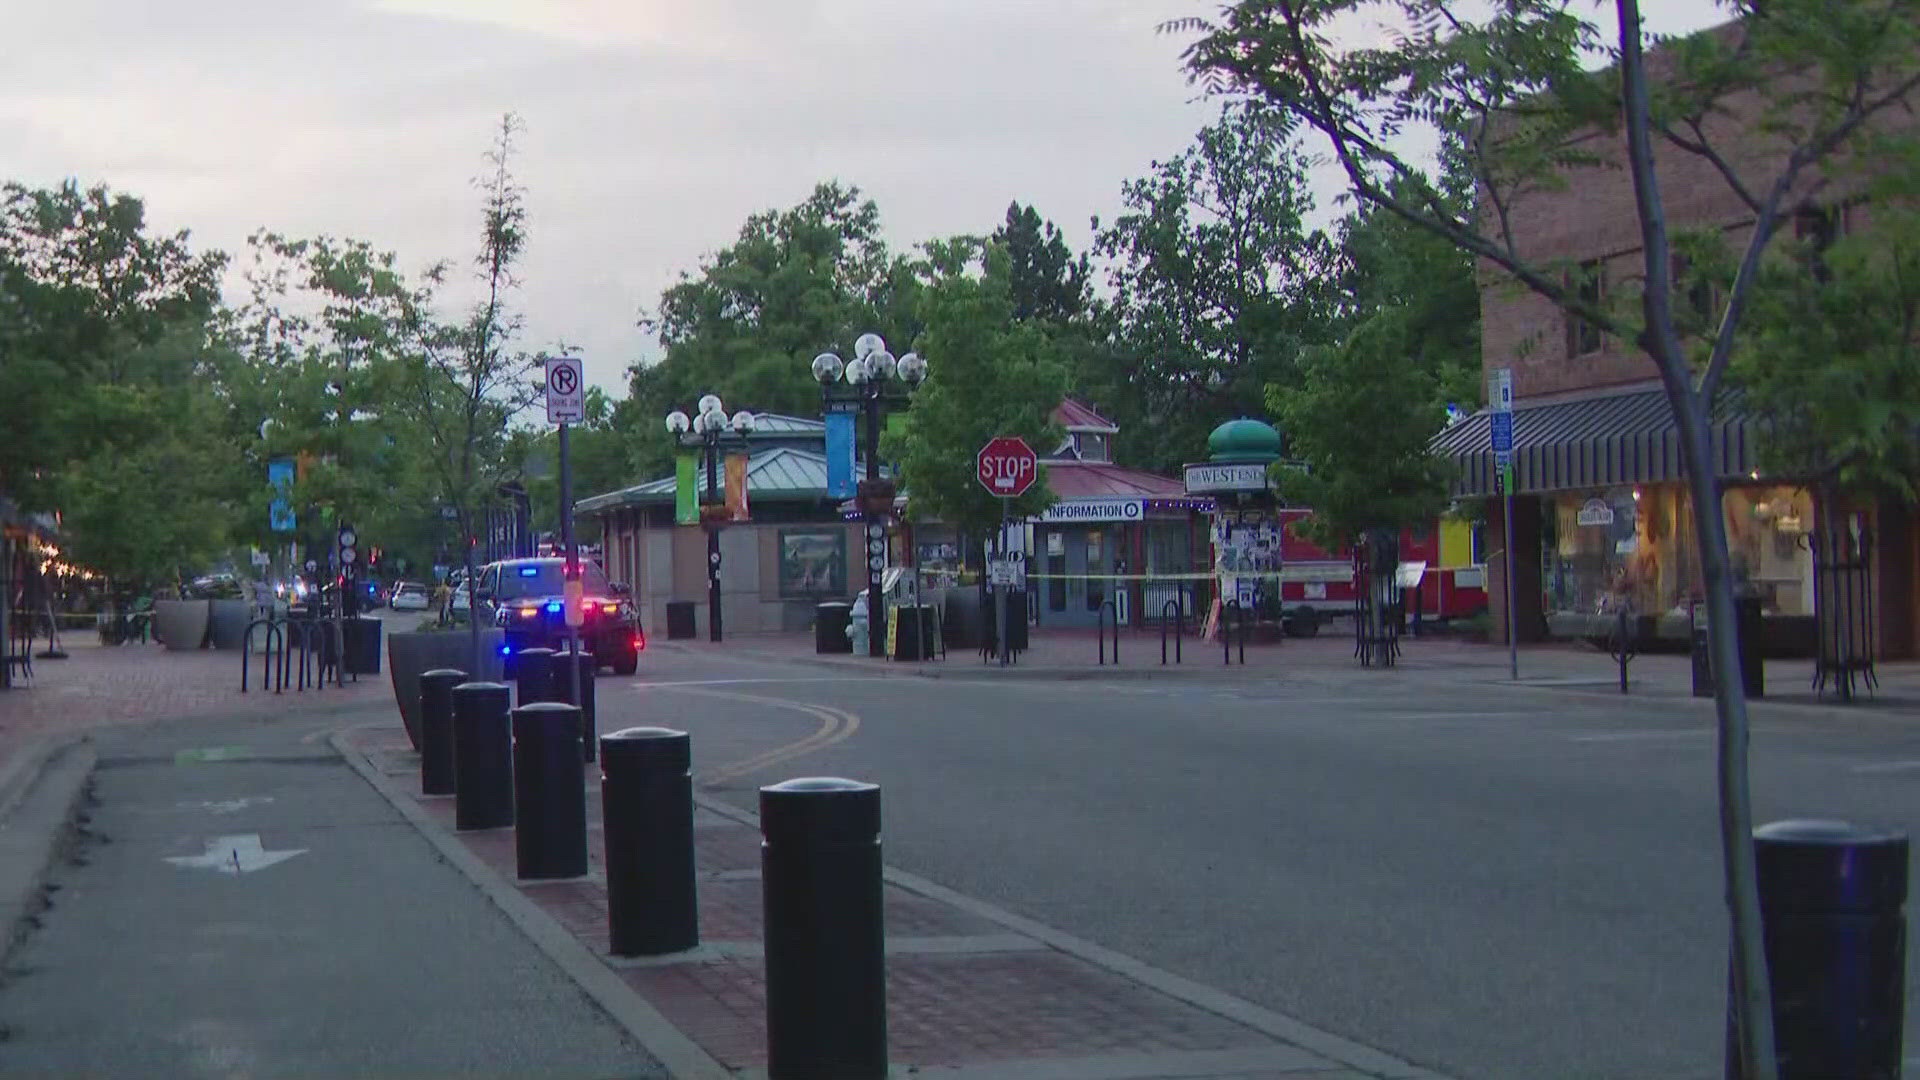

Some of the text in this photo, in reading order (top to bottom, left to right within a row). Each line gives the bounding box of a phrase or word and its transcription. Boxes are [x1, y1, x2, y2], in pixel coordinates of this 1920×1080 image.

[982, 456, 1032, 479] STOP
[1201, 468, 1235, 483] WEST
[1048, 504, 1123, 518] INFORMATION
